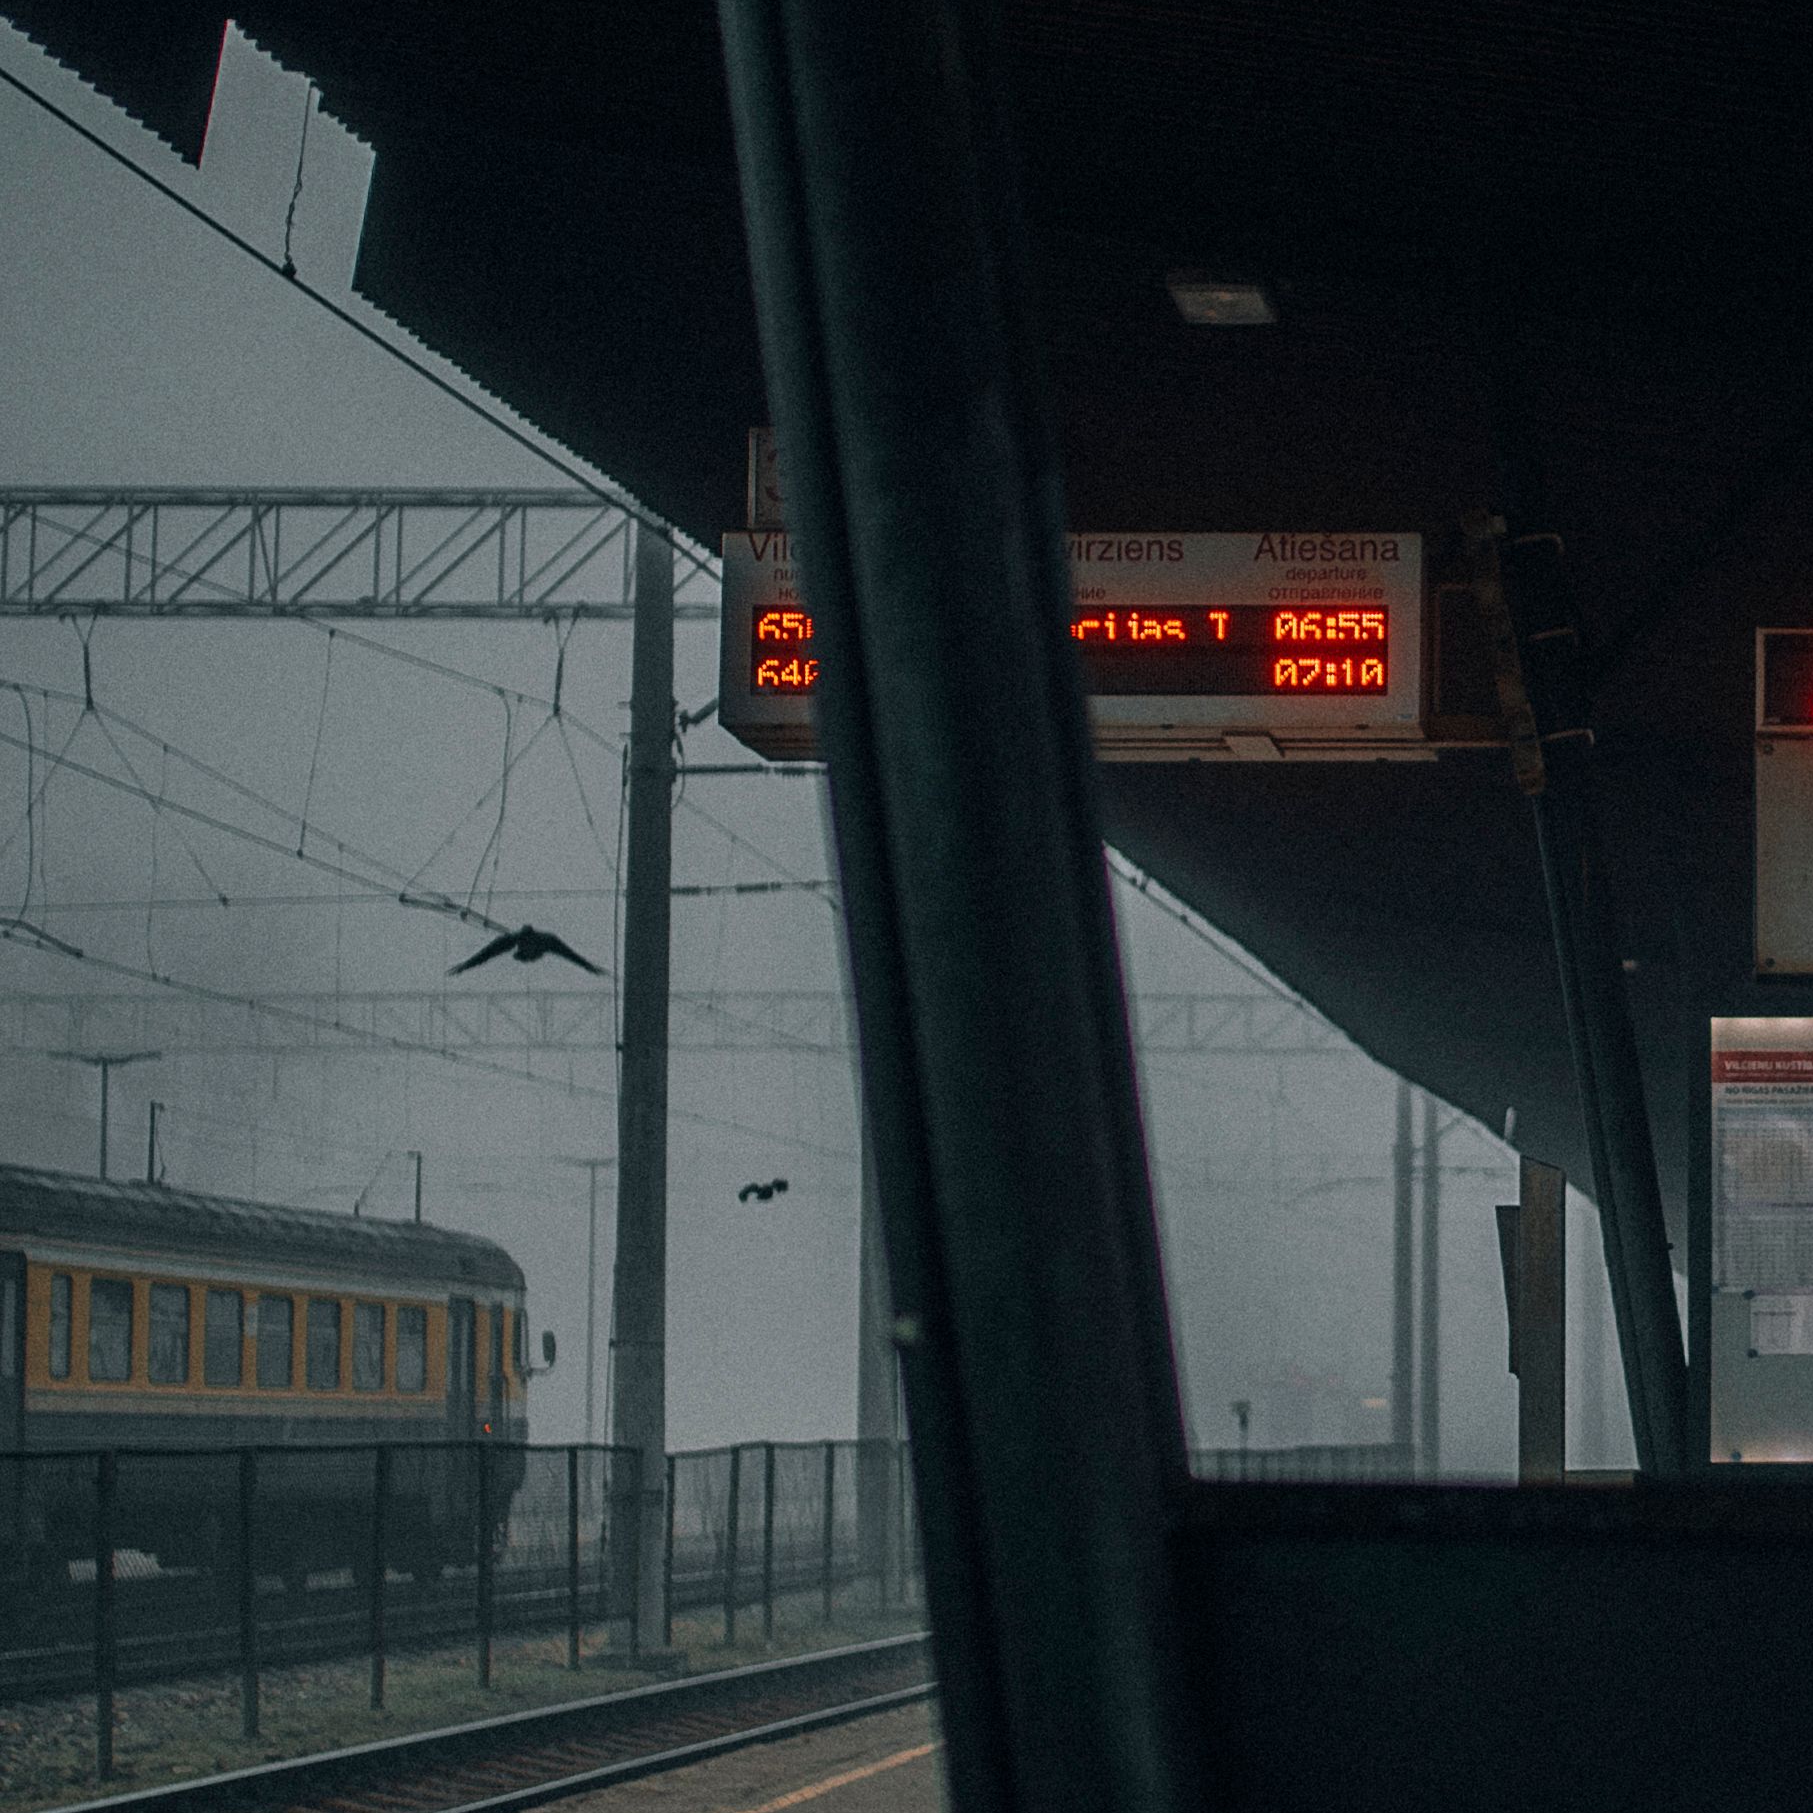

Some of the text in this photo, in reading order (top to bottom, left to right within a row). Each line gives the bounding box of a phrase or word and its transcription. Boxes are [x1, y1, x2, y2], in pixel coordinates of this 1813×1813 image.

[1253, 532, 1400, 562] Atiešana
[1285, 566, 1368, 583] departure
[1267, 586, 1385, 602] отправление
[1273, 611, 1386, 641] 06:55
[1273, 657, 1386, 687] 07:10
